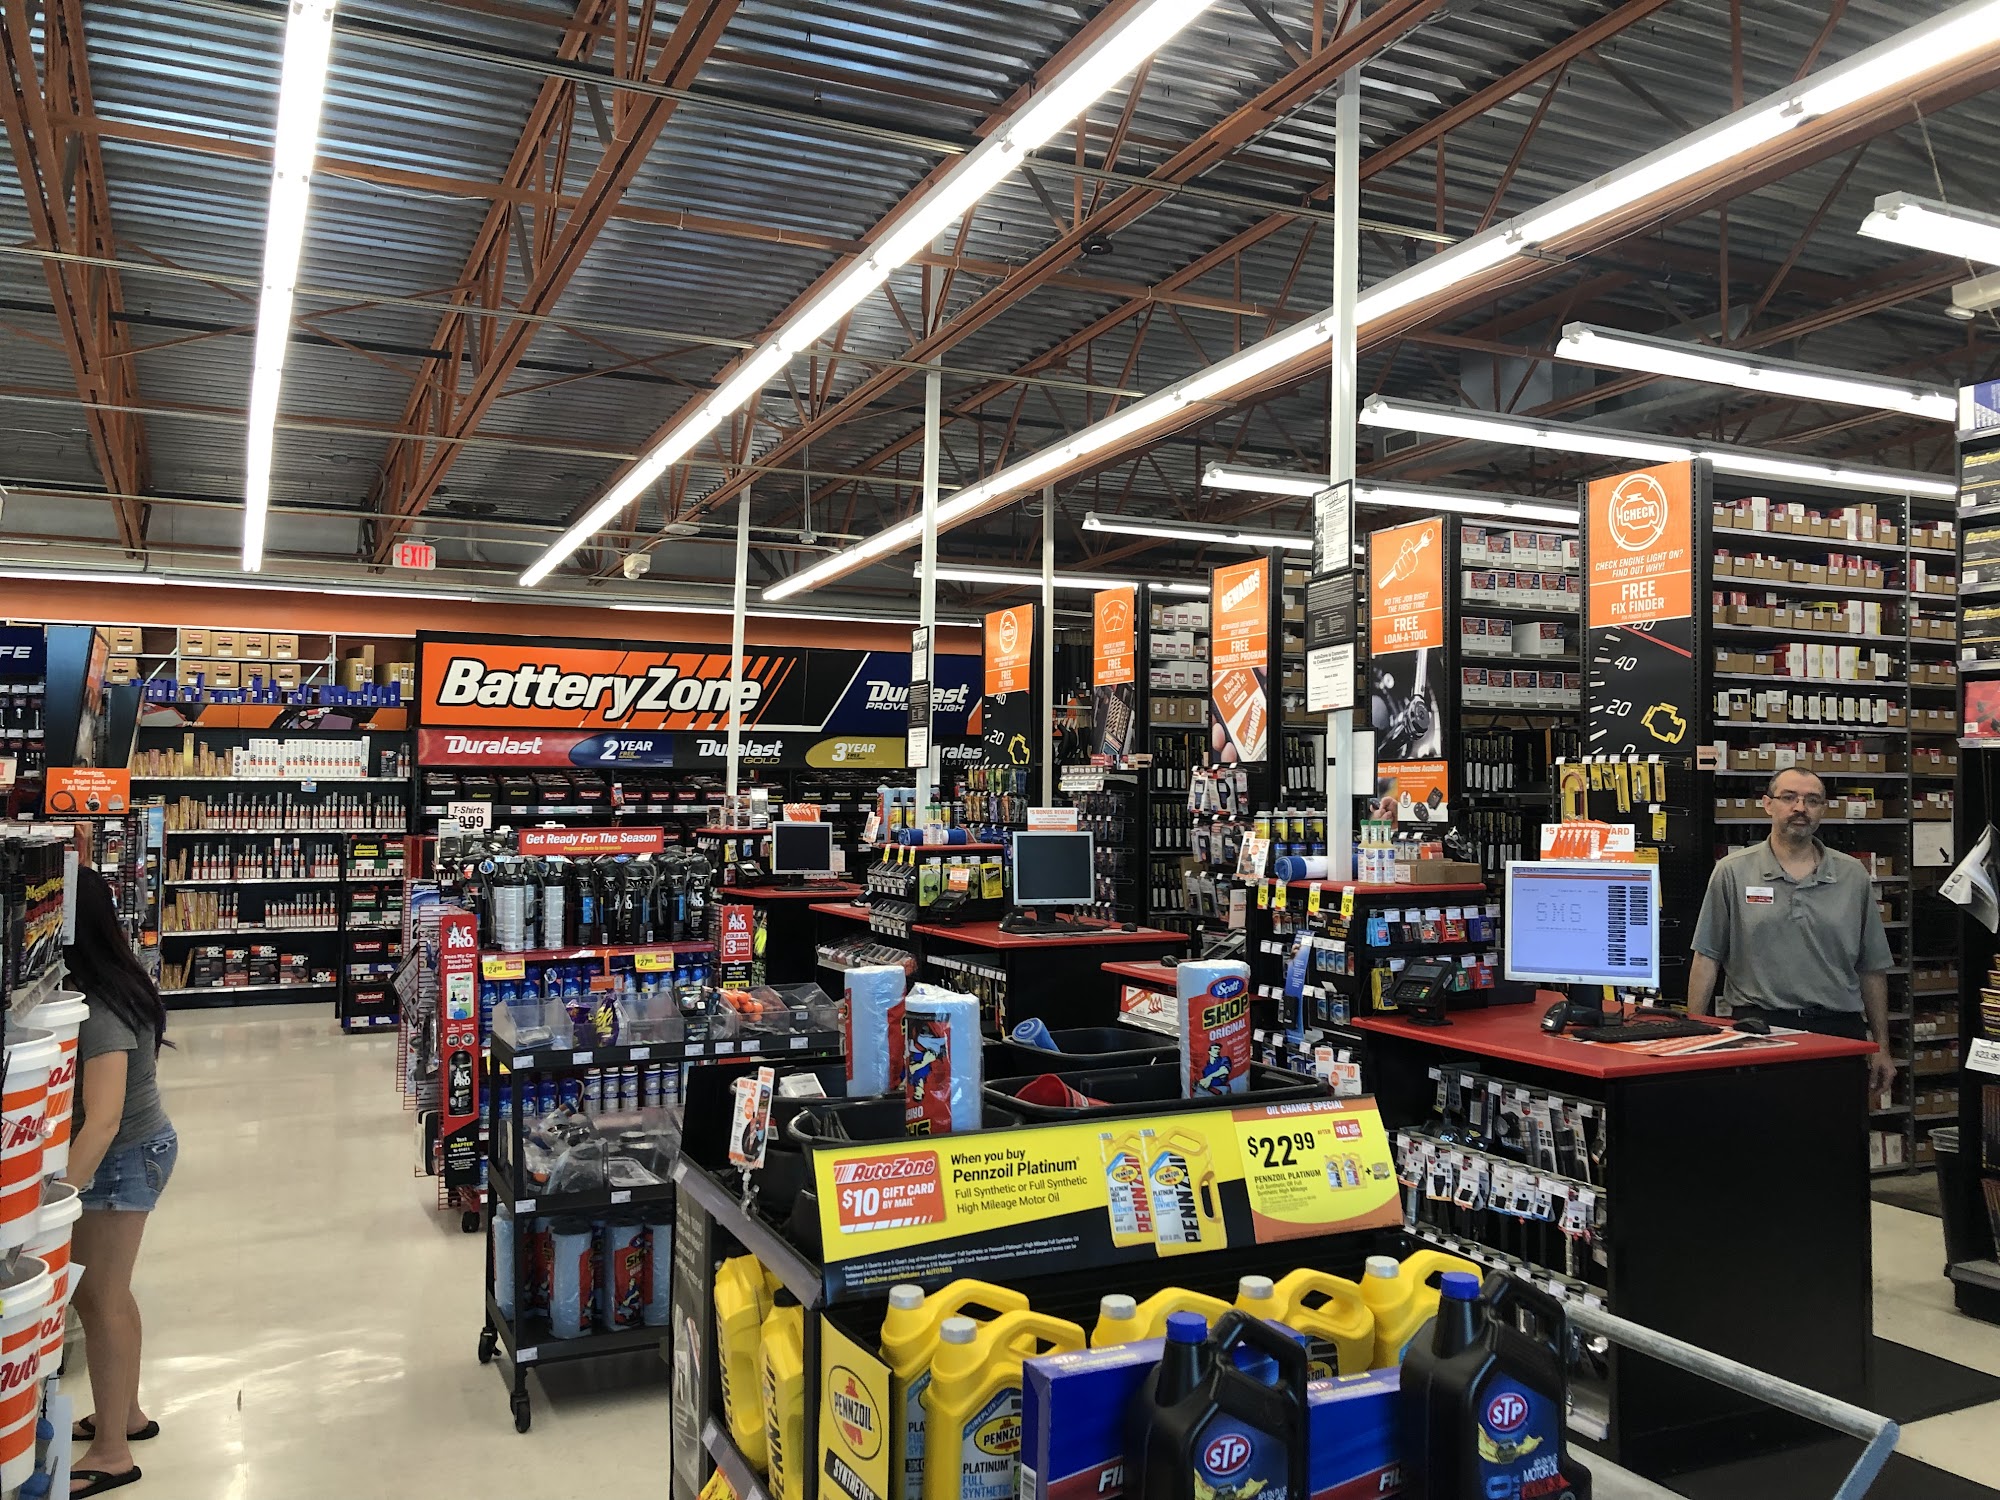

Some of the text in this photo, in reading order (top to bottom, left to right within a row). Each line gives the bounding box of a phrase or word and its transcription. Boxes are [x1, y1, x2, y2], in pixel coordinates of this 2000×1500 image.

[1623, 505, 1655, 521] CHECK
[402, 547, 430, 567] EXIT
[1595, 549, 1683, 571] CHECK ENGINE LIGHT ON?
[1612, 562, 1665, 578] FIND OUT WHY!
[1222, 569, 1260, 613] REWARDS
[1622, 580, 1656, 601] FREE
[1611, 597, 1665, 615] FIX FINDER
[1394, 616, 1418, 632] FREE
[1231, 639, 1249, 653] FREE
[1384, 629, 1428, 645] LOAN-A-TOOL
[1107, 658, 1121, 670] FREE
[1214, 649, 1267, 664] REWARDS PROGRAM
[1615, 655, 1637, 671] 40
[439, 659, 761, 719] BatteryZone
[866, 681, 969, 704] Durast
[865, 702, 965, 712] PROVE OUGH
[1606, 699, 1632, 717] 20
[444, 736, 543, 755] Duralast
[989, 730, 1005, 745] 20
[600, 740, 653, 760] 2 YEAR
[696, 739, 783, 757] Dualast
[832, 743, 876, 761] 3 YEAR
[942, 744, 983, 759] ralas
[743, 757, 780, 765] GOLD
[453, 806, 484, 814] T-Shirts
[526, 833, 657, 846] Get Ready For The Season
[1611, 827, 1629, 835] ARD
[448, 937, 474, 948] PRO
[1217, 980, 1240, 996] Scott
[1203, 993, 1249, 1029] SHOP
[1209, 1019, 1246, 1040] ORIGINAL
[1266, 1100, 1344, 1115] OIL CHANGE SPECIAL
[951, 1148, 1026, 1165] When you buy
[852, 1157, 935, 1182] AutoZone
[953, 1158, 1078, 1183] Pennzoil Platinum
[1254, 1169, 1321, 1183] PENNZOIL PLATINUM
[882, 1181, 935, 1199] GIFT CARD
[955, 1175, 1087, 1199] Full Synthetic or Full Synthetic
[842, 1187, 879, 1217] $10
[883, 1197, 914, 1209] BY MAIL
[957, 1193, 1060, 1215] High Mileage Motor Oil
[834, 1391, 872, 1431] PENNZOIL
[1493, 1398, 1523, 1425] STP
[984, 1426, 1021, 1446] PENNZO
[1210, 1439, 1246, 1469] STP
[963, 1460, 1008, 1474] PLATINUM
[833, 1458, 874, 1500] SYNTHETICS
[963, 1475, 984, 1486] FULL
